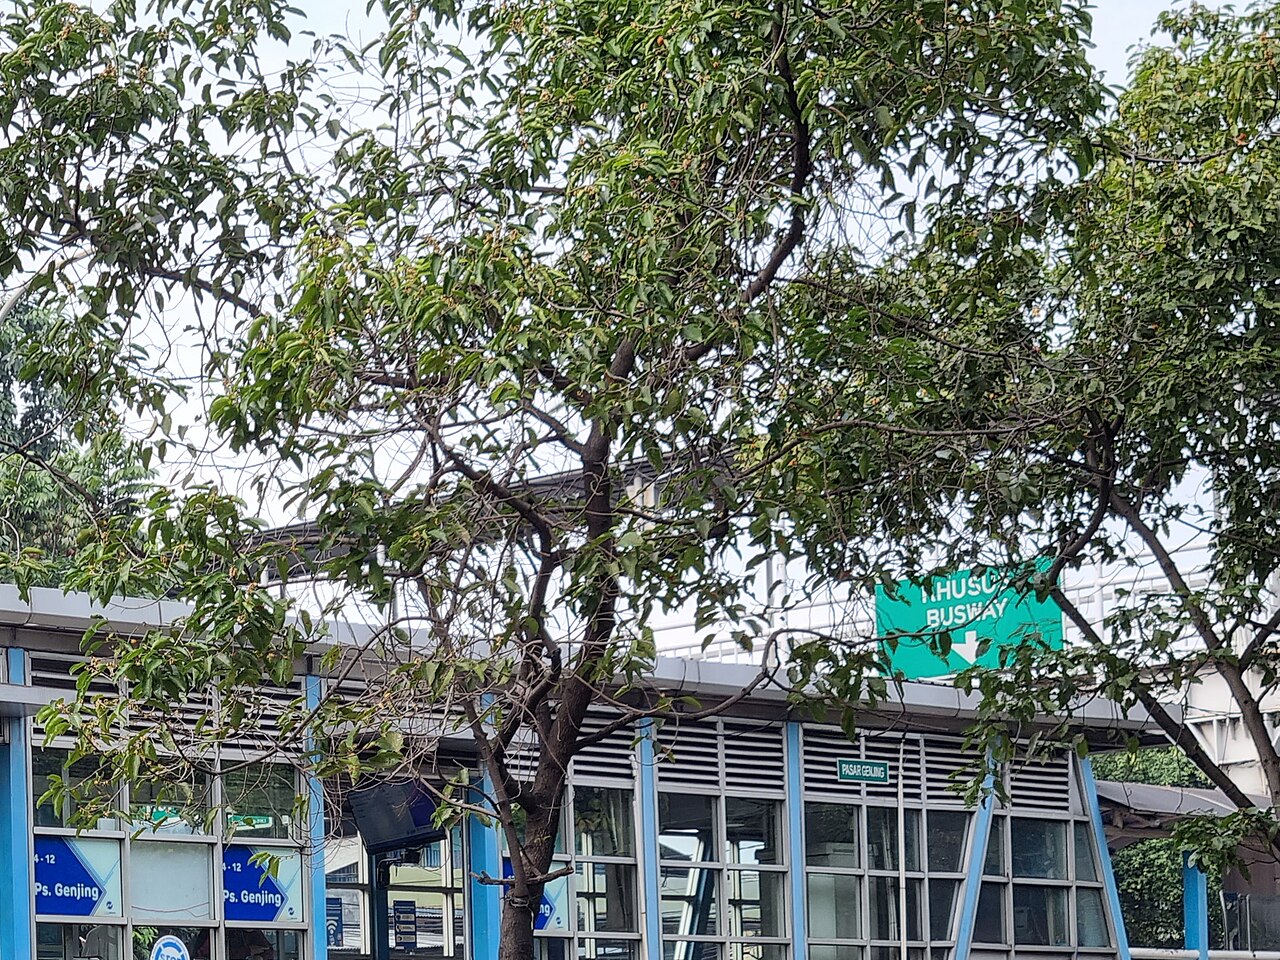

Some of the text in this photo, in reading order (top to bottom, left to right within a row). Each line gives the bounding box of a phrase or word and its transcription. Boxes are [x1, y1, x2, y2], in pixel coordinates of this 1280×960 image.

[926, 598, 1009, 629] BUSWAY
[841, 763, 862, 776] PASAR
[45, 854, 56, 864] 12
[232, 862, 242, 872] 12
[34, 882, 99, 901] Ps. Genjing
[223, 889, 281, 908] Ps. Genjing
